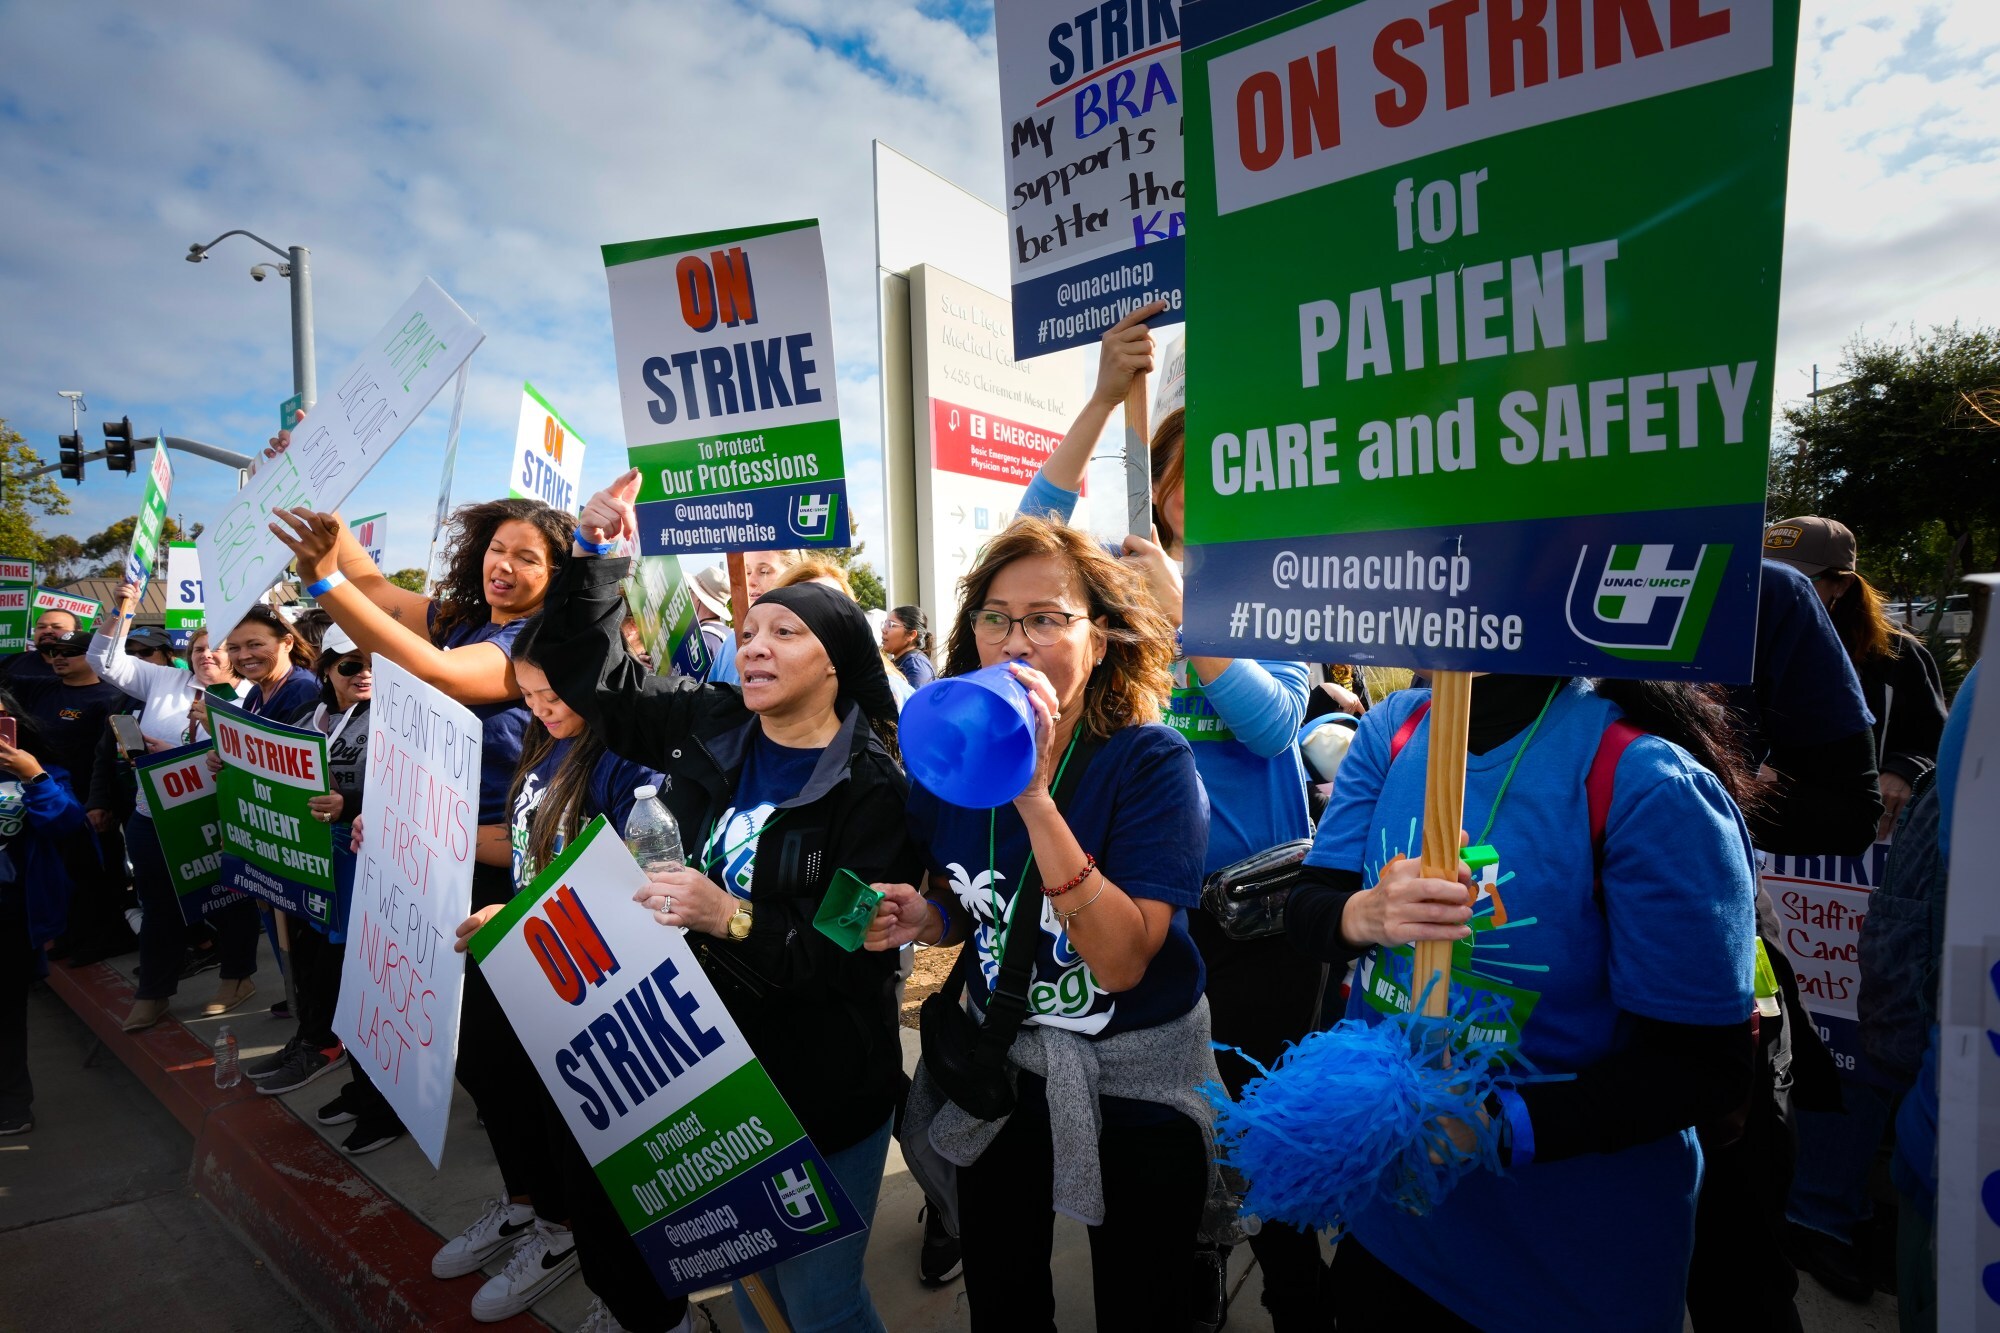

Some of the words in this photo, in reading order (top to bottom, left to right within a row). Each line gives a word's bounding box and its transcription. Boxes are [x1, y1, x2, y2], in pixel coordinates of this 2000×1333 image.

[1048, 0, 1180, 86] STRIK
[1010, 115, 1055, 159] My
[1075, 62, 1178, 139] BRA
[1236, 46, 1341, 173] ON
[1011, 126, 1156, 210] supports
[1016, 202, 1109, 264] better
[1393, 167, 1488, 252] for
[676, 247, 758, 333] ON
[941, 293, 967, 320] San
[1057, 261, 1153, 307] @unacuhcp
[1298, 238, 1619, 388] PATIENT
[942, 324, 992, 360] Medical
[642, 332, 822, 425] STRIKE
[544, 415, 564, 467] ON
[698, 441, 713, 460] To
[715, 434, 766, 457] Protect
[970, 444, 987, 457] Basic
[989, 449, 1020, 466] Emergency
[1211, 417, 1340, 497] CARE
[1358, 397, 1477, 481] and
[1499, 361, 1758, 466] SAFETY
[522, 449, 572, 512] STRIKE
[660, 467, 693, 495] Our
[697, 452, 819, 492] Professions
[971, 457, 1000, 471] Physician
[1002, 466, 1009, 474] on
[1011, 466, 1024, 479] Duty
[660, 523, 776, 546] #TogetherWeRise
[675, 500, 754, 521] @unacuhcp
[1272, 550, 1471, 597] @unacuhcp
[1603, 577, 1692, 589] UNAC/UHCP
[39, 595, 55, 606] ON
[57, 599, 94, 615] STRIKE
[181, 617, 198, 628] Our
[1229, 602, 1524, 651] #TogetherWeRise
[374, 671, 400, 732] WE
[444, 720, 477, 790] PUT
[1167, 714, 1190, 729] RISE
[1197, 719, 1212, 732] WE
[219, 723, 242, 758] ON
[244, 734, 315, 781] STRIKE
[162, 765, 203, 797] ON
[252, 778, 272, 803] for
[373, 731, 469, 861] PATIENTS
[238, 798, 300, 843] PATIENT
[226, 823, 254, 852] CARE
[255, 839, 279, 863] and
[282, 847, 330, 878] SAFETY
[382, 806, 438, 895] FIRST
[234, 874, 297, 911] #TogetherWeRise
[245, 863, 284, 893] @unacuhcp
[379, 870, 405, 934] WE
[406, 903, 443, 978] PUT
[523, 884, 621, 1006] ON
[360, 911, 436, 1046] NURSES
[1375, 978, 1396, 1004] WE
[357, 991, 410, 1084] LAST
[555, 957, 726, 1131] STRIKE
[643, 1137, 662, 1164] To
[656, 1111, 706, 1158] Protect
[631, 1177, 666, 1217] Our
[656, 1115, 774, 1203] Professions
[666, 1203, 738, 1248] @unacuhcp
[668, 1225, 778, 1284] #TogetherWeRise
